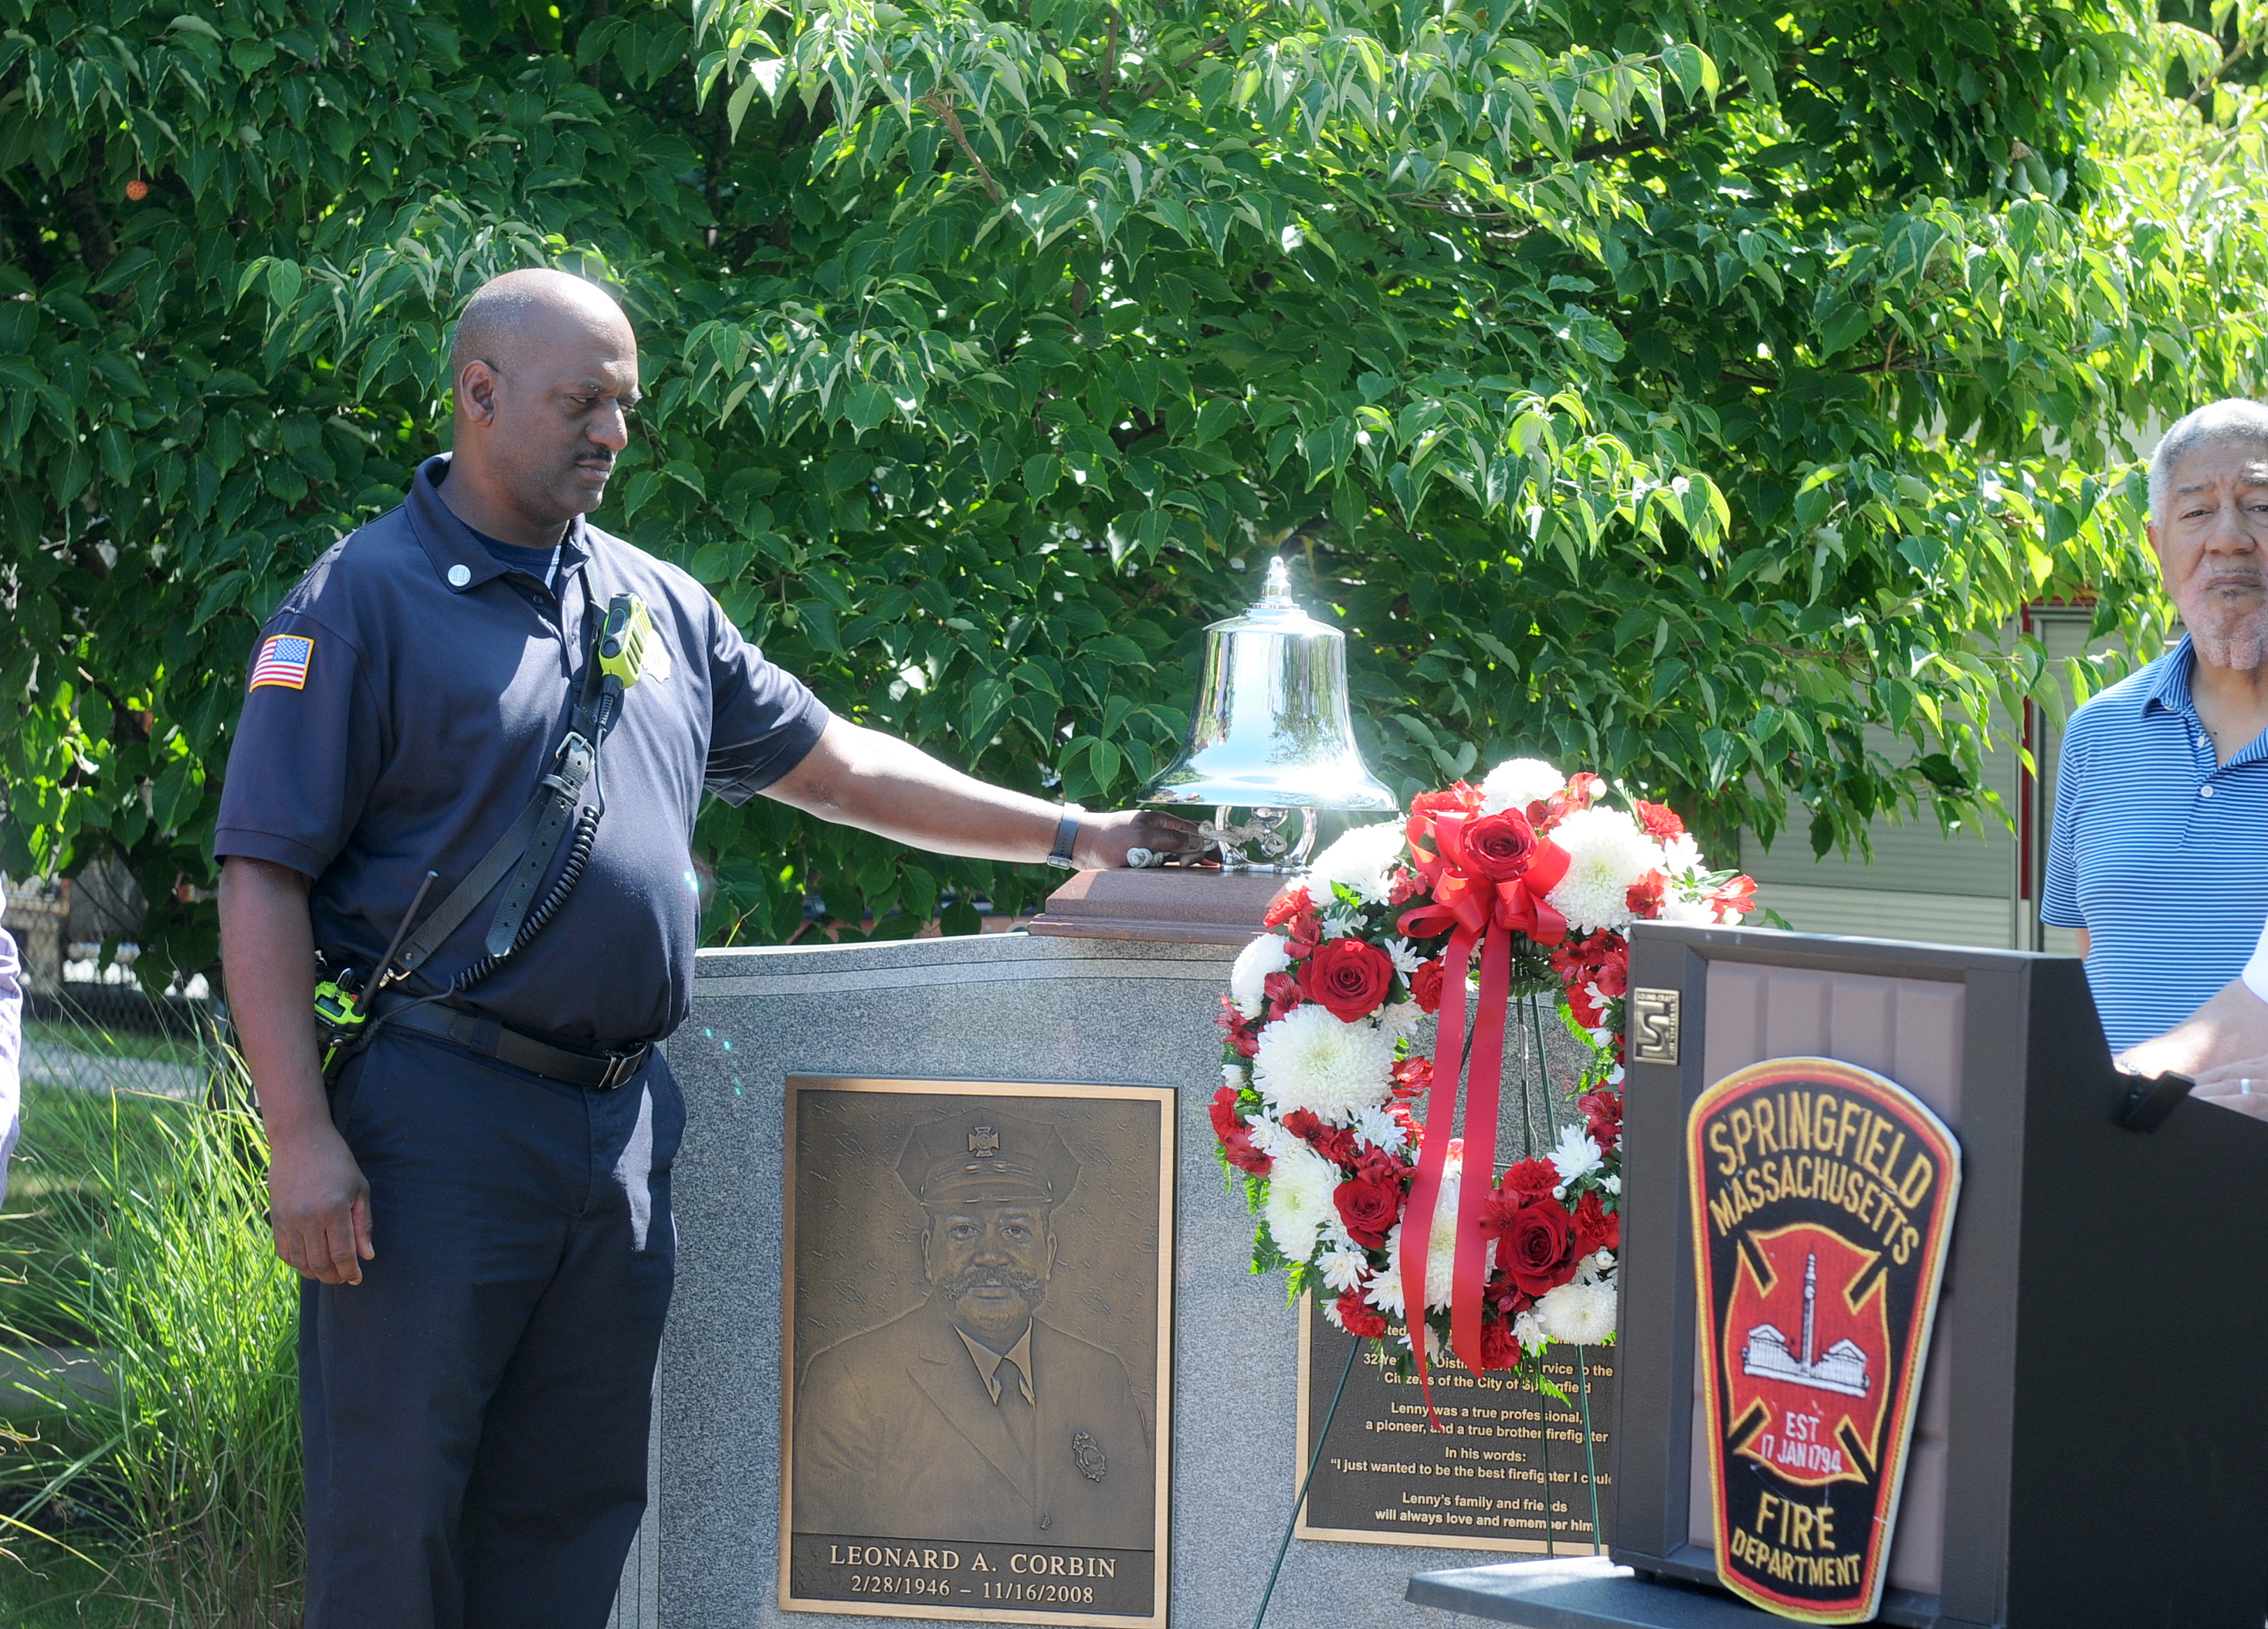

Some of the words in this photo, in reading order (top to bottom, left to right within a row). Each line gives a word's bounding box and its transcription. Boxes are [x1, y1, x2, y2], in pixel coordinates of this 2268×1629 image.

[1710, 1092, 1933, 1209] SPRINGFIELD
[1709, 1156, 1920, 1265] MASSACHUSETTS
[1364, 1353, 1378, 1364] 32
[1528, 1362, 1573, 1374] rvice
[1593, 1365, 1613, 1377] the
[1385, 1372, 1435, 1386] Citzes
[1438, 1375, 1452, 1387] of
[1454, 1376, 1474, 1387] the
[1477, 1377, 1503, 1391] City
[1506, 1379, 1519, 1390] of
[1522, 1380, 1591, 1394] Spgfied
[1391, 1402, 1429, 1417] Lenny
[1432, 1406, 1458, 1417] was
[1461, 1408, 1469, 1417] a
[1473, 1407, 1497, 1418] true
[1365, 1421, 1373, 1430] a
[1377, 1420, 1426, 1434] pioneer,
[1457, 1426, 1464, 1435] a
[1468, 1424, 1493, 1436] true
[1497, 1426, 1541, 1439] brother
[1546, 1428, 1609, 1444] firefigter
[1785, 1411, 1820, 1442] EST
[1445, 1447, 1457, 1458] In
[1461, 1448, 1480, 1460] his
[1483, 1450, 1527, 1462] words:
[1761, 1434, 1775, 1460] 17
[1777, 1438, 1807, 1467] JAN
[1809, 1444, 1843, 1474] 1794
[1343, 1459, 1368, 1473] just
[1371, 1462, 1416, 1473] wanted
[1419, 1465, 1432, 1475] to
[1436, 1464, 1451, 1475] be
[1454, 1465, 1474, 1478] the
[1478, 1466, 1506, 1479] best
[1574, 1472, 1578, 1483] I
[1402, 1492, 1452, 1508] Lenny’s
[1455, 1495, 1493, 1511] family
[1497, 1499, 1520, 1510] and
[1375, 1509, 1396, 1521] will
[1400, 1510, 1443, 1525] always
[1446, 1512, 1473, 1525] love
[1476, 1516, 1500, 1526] and
[1571, 1519, 1593, 1532] him
[1756, 1491, 1836, 1551] FIRE
[830, 1545, 961, 1570] LEONARD
[971, 1551, 998, 1573] A.
[1010, 1553, 1117, 1579] CORBIN
[1731, 1528, 1861, 1587] DEPARTMENT
[851, 1575, 951, 1597] 2/28/1946
[983, 1581, 1094, 1604] 11/16/2008
